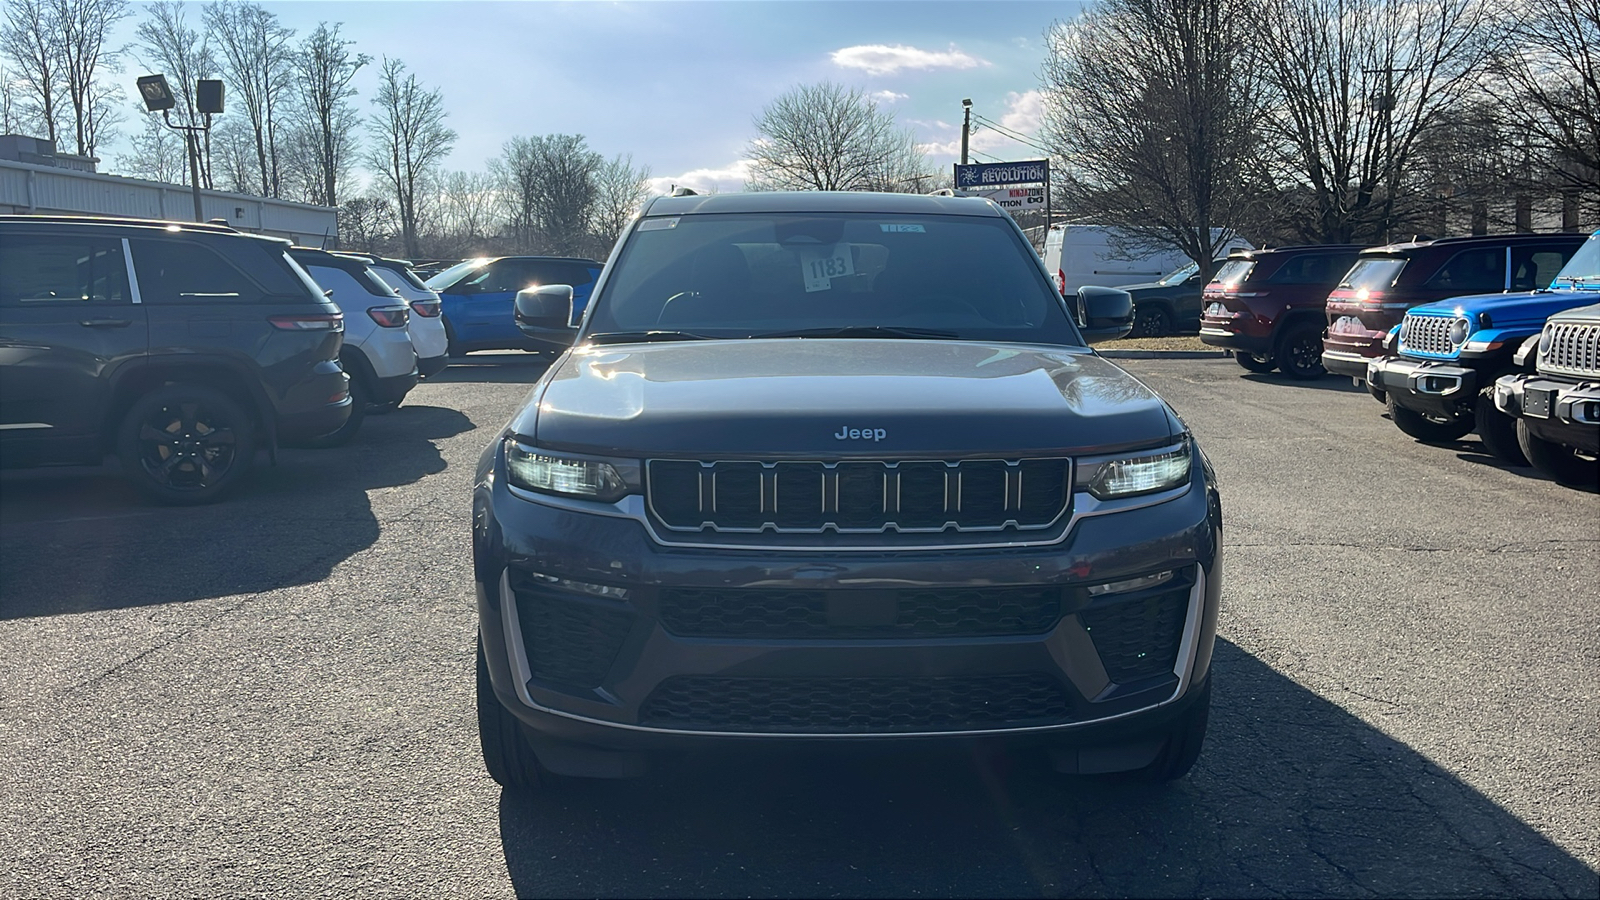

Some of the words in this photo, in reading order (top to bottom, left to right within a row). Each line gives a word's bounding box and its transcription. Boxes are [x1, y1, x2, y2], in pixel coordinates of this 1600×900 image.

[982, 169, 1044, 183] REVOLUTION
[810, 257, 847, 279] 1183
[834, 426, 887, 442] Jeep
